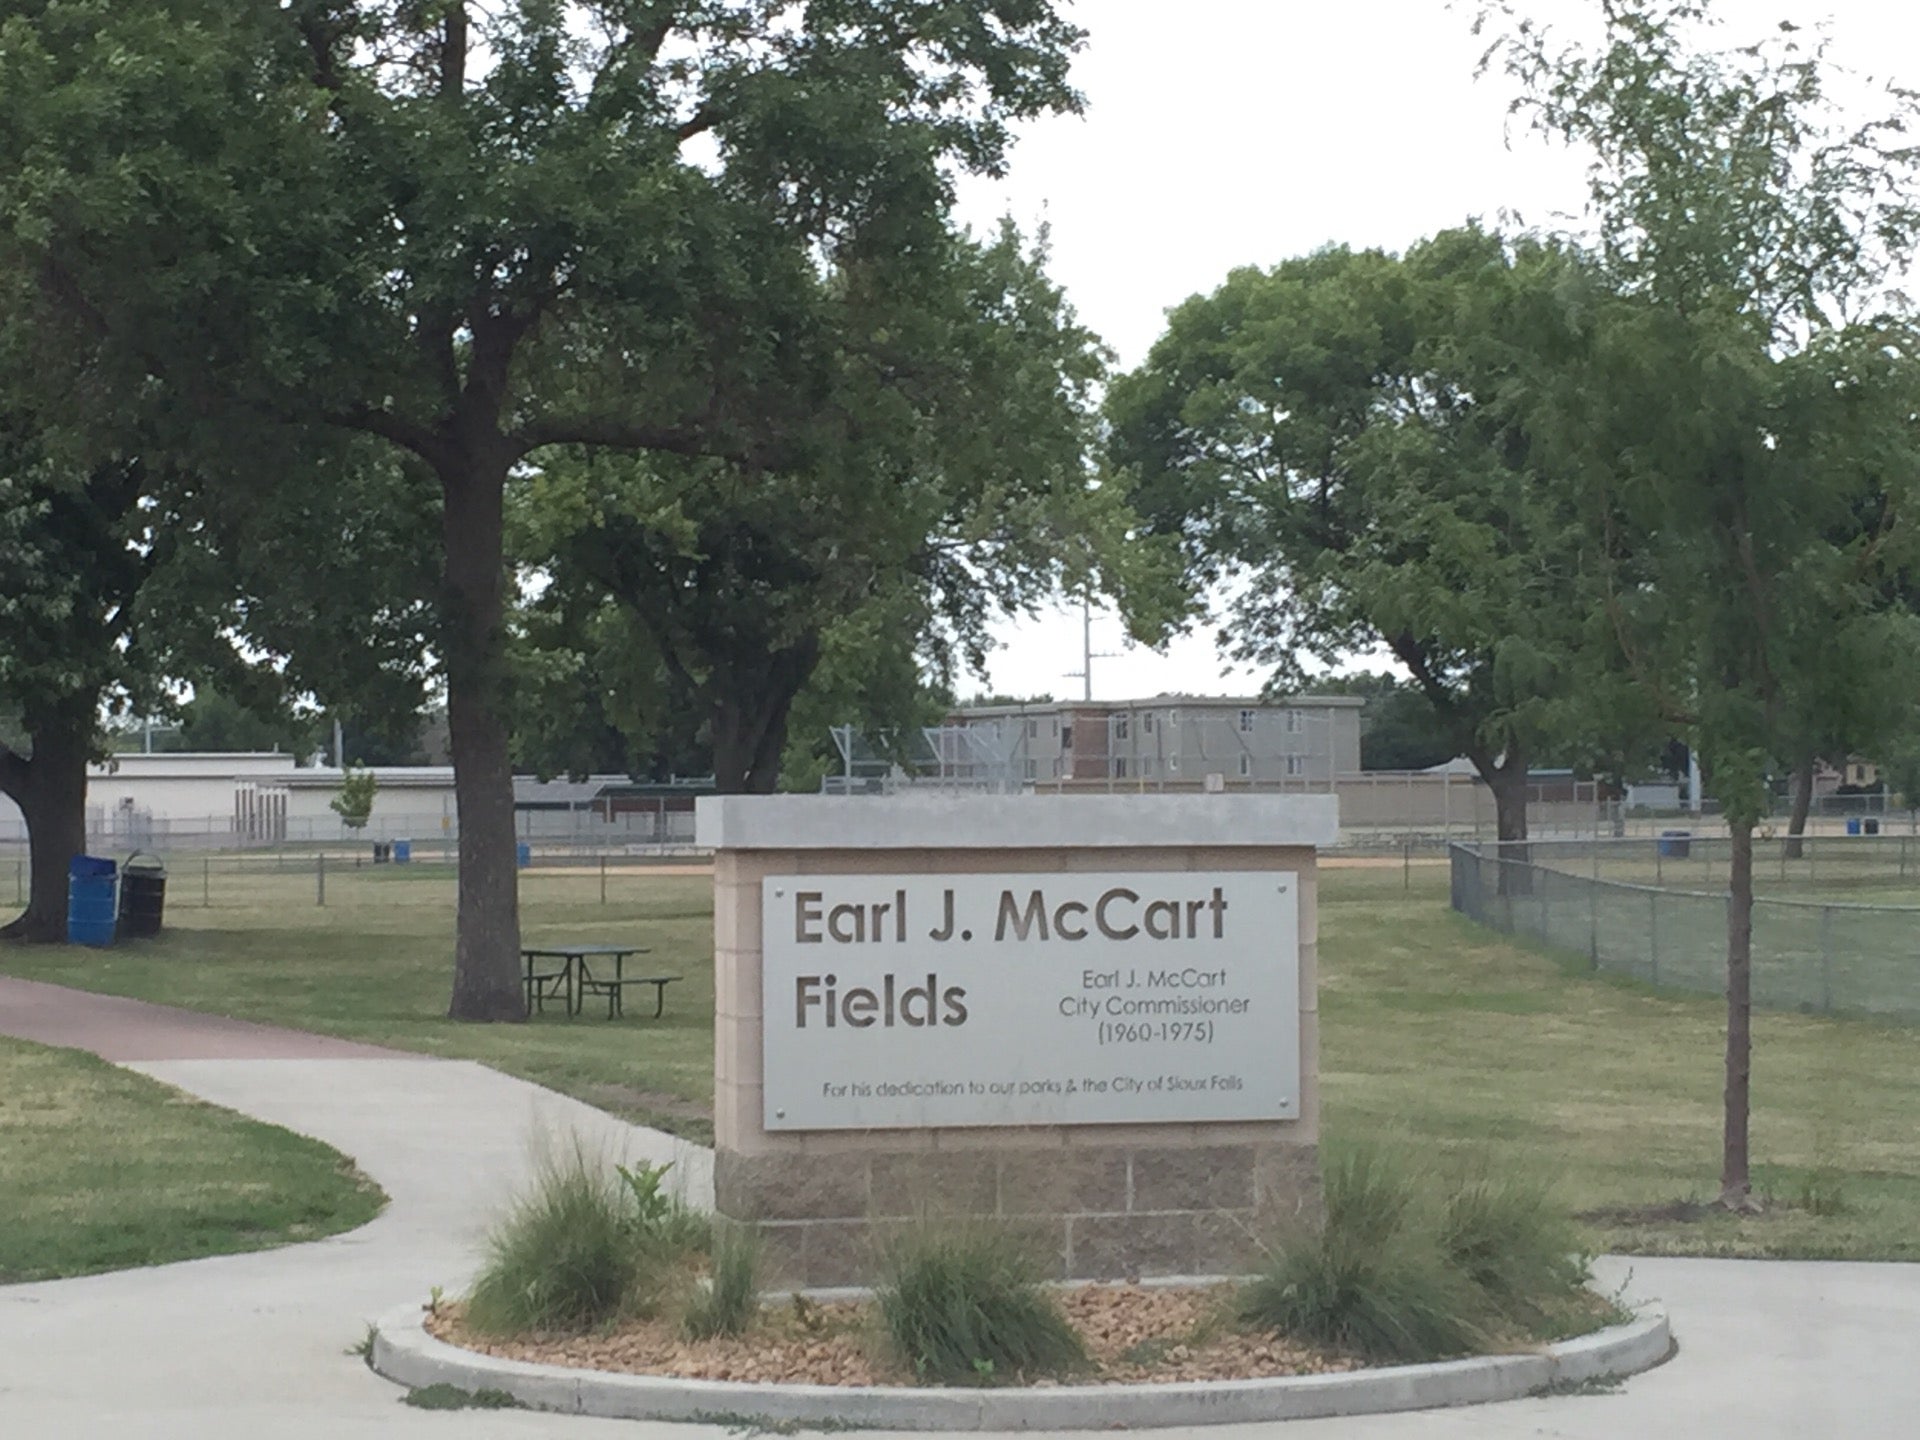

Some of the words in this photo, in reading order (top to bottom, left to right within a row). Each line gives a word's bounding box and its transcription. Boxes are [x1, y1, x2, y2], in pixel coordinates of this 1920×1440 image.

[795, 889, 906, 944] Earl
[929, 889, 972, 942] J.
[994, 887, 1228, 943] McCart
[1082, 969, 1120, 989] Earl
[1126, 969, 1141, 988] J.
[1147, 968, 1227, 988] McCart
[796, 973, 968, 1028] Fields
[1058, 996, 1101, 1019] City
[1105, 995, 1250, 1016] Commissioner
[1098, 1019, 1214, 1045] (1960-1975)
[823, 1082, 847, 1097] For
[851, 1082, 872, 1097] his
[876, 1081, 964, 1097] dedication
[968, 1081, 985, 1095] to
[989, 1082, 1016, 1095] our
[1019, 1079, 1062, 1096] parks
[1065, 1078, 1078, 1093] &
[1082, 1078, 1108, 1093] the
[1111, 1077, 1143, 1095] City
[1146, 1076, 1164, 1091] of
[1167, 1075, 1207, 1091] Sioux
[1210, 1074, 1243, 1090] Falls
